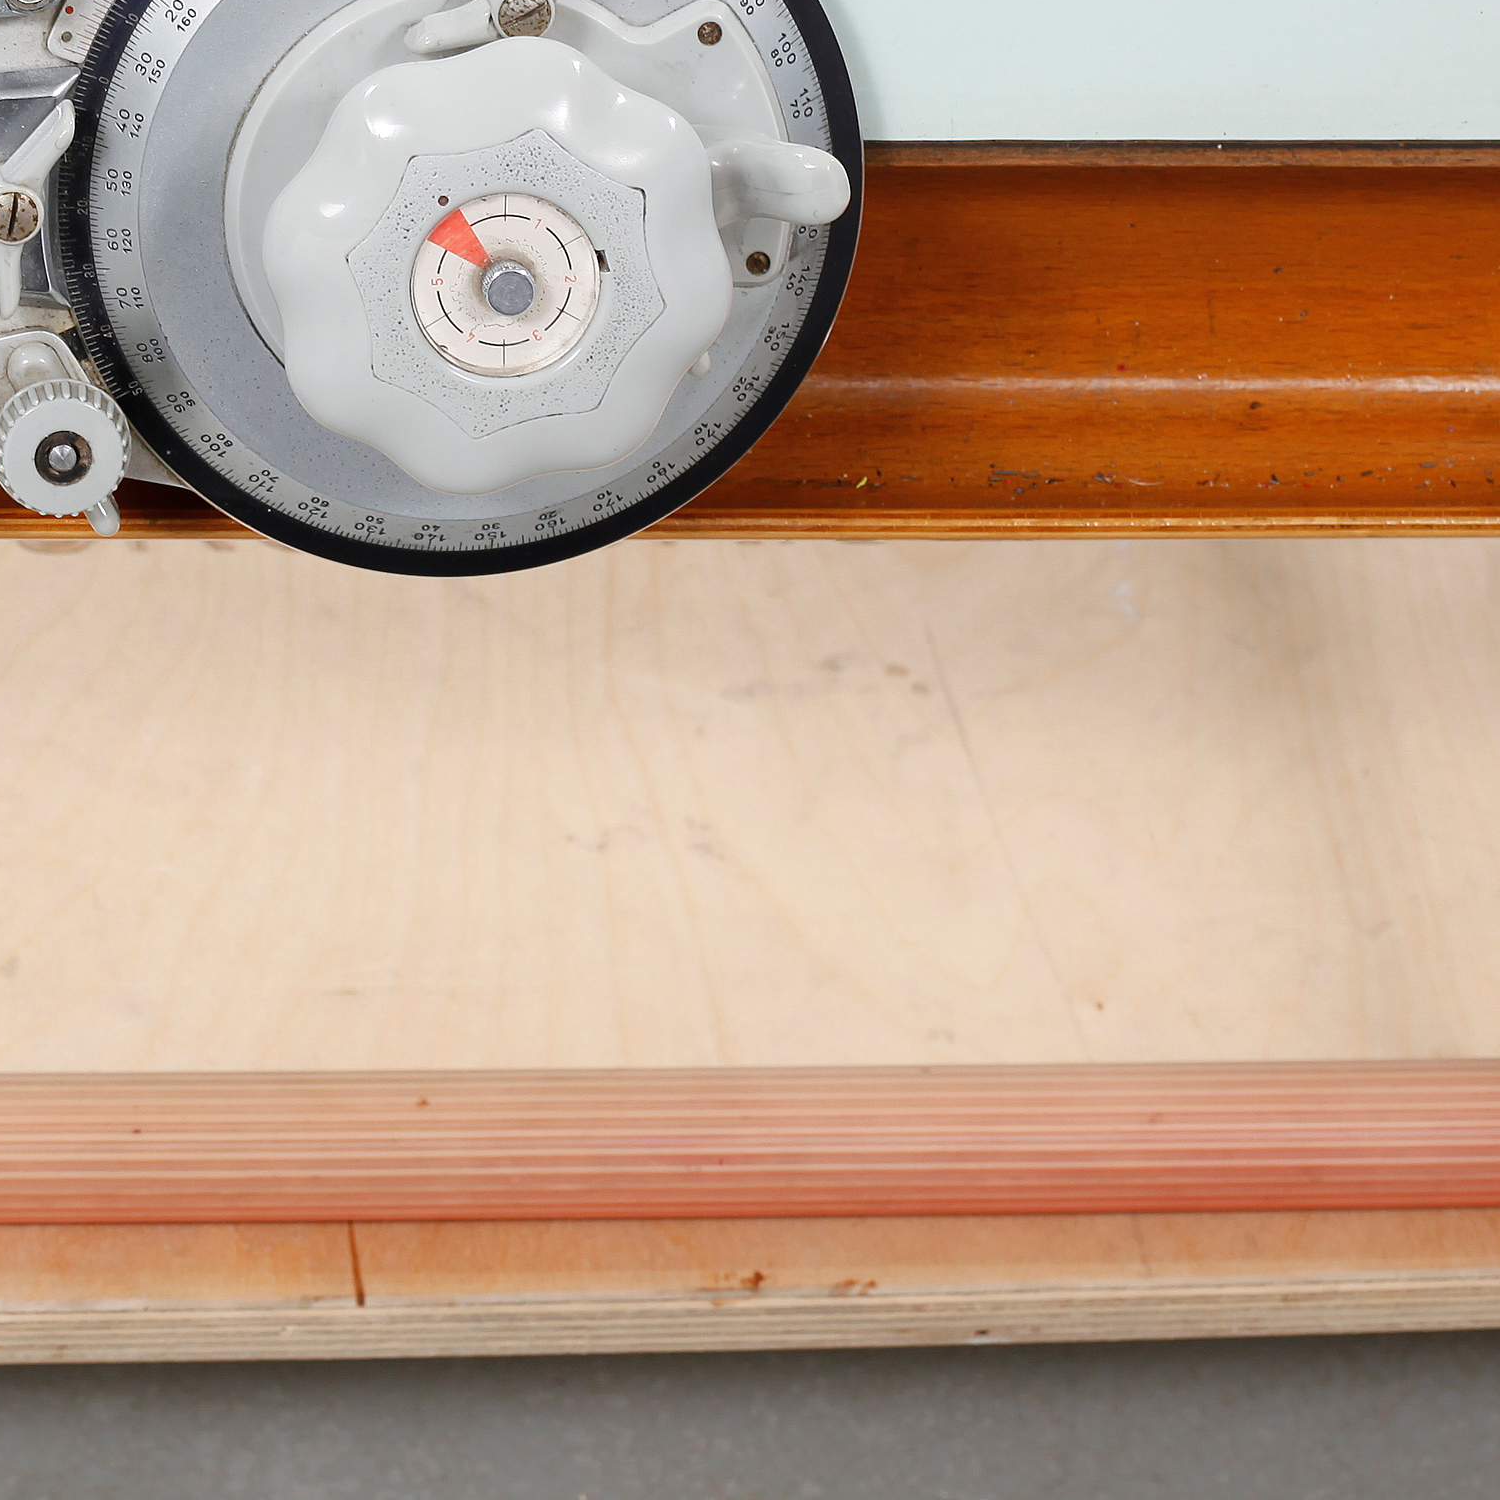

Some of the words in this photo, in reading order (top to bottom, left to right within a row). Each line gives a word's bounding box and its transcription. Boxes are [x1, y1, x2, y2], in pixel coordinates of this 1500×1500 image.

[125, 13, 138, 26] 10
[165, 0, 184, 22] 20
[177, 8, 197, 32] 160
[777, 33, 796, 64] 100
[135, 52, 152, 76] 30
[771, 49, 783, 67] 80
[99, 77, 109, 85] 0
[148, 60, 166, 85] 150
[790, 100, 800, 118] 70
[800, 88, 813, 117] 110
[115, 109, 130, 133] 40
[129, 113, 144, 139] 140
[106, 169, 119, 191] 50
[121, 171, 132, 197] 130
[77, 199, 88, 215] 20
[536, 218, 542, 229] 1
[107, 229, 118, 250] 60
[122, 229, 132, 254] 120
[83, 263, 94, 278] 30
[565, 275, 578, 283] 2
[431, 278, 444, 286] 5
[786, 273, 796, 290] 40
[795, 265, 810, 296] 140
[116, 288, 131, 309] 70
[131, 287, 144, 310] 110
[101, 325, 113, 338] 40
[466, 332, 476, 344] 4
[533, 329, 542, 341] 3
[764, 326, 776, 343] 30
[770, 322, 790, 351] 150
[137, 343, 153, 363] 80
[150, 339, 166, 362] 100
[129, 381, 142, 396] 50
[733, 377, 746, 392] 20
[737, 375, 760, 401] 160
[166, 394, 185, 412] 90
[180, 391, 195, 406] 90
[695, 423, 708, 435] 10
[696, 422, 721, 446] 170
[201, 434, 227, 458] 100
[217, 433, 233, 447] 80
[262, 470, 279, 483] 70
[647, 463, 675, 483] 180
[249, 474, 273, 493] 110
[311, 497, 330, 507] 60
[597, 490, 612, 499] 10
[298, 502, 328, 519] 120
[593, 495, 623, 512] 170
[366, 515, 385, 524] 50
[539, 510, 557, 520] 20
[355, 522, 386, 535] 130
[535, 518, 566, 531] 160
[414, 533, 446, 541] 140
[475, 531, 506, 540] 150
